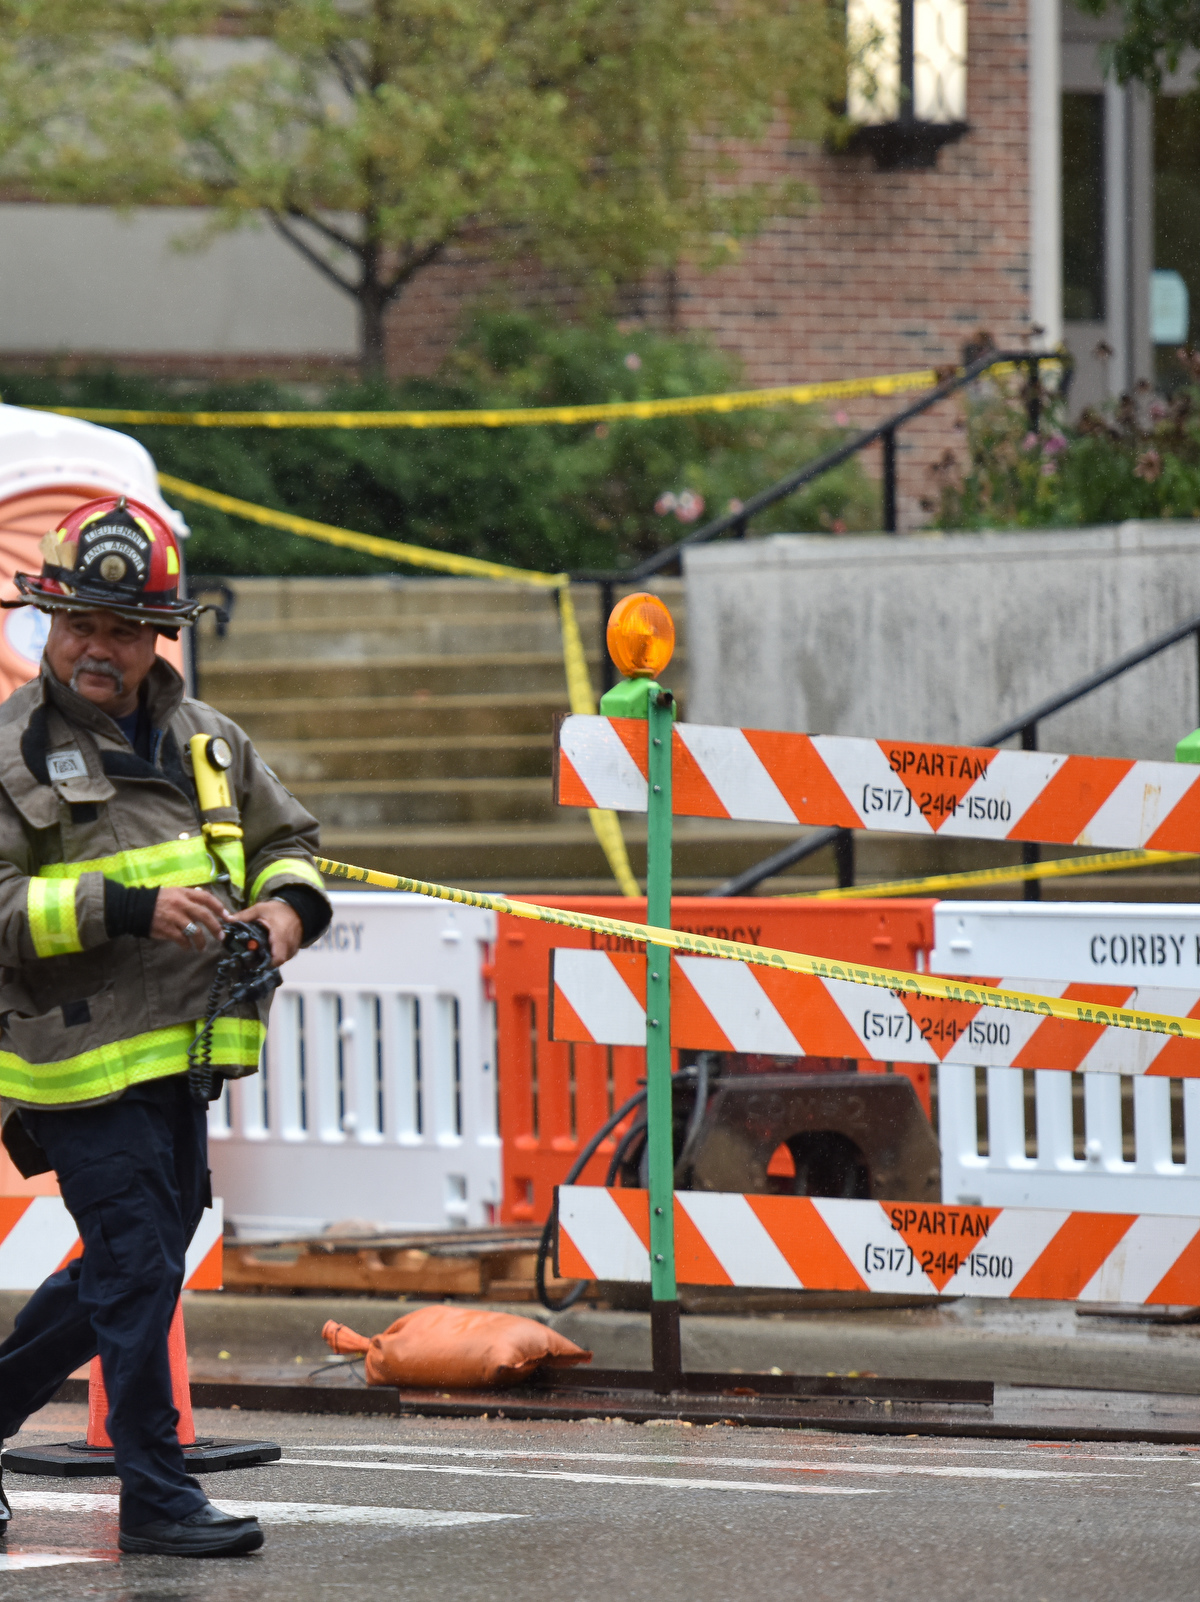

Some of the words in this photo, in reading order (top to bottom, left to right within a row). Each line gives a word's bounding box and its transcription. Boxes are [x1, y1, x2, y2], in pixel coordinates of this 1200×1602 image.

[88, 525, 143, 545] LIEUTENANT
[87, 543, 106, 560] ANN
[111, 541, 142, 567] ARBOR
[889, 750, 988, 780] SPARTAN
[862, 783, 913, 817] (517)
[920, 792, 1012, 823] 244-1500
[1090, 934, 1185, 965] CORBY
[863, 1010, 913, 1044] (517)
[920, 1016, 1011, 1047] 244-1500
[890, 1209, 989, 1239] SPARTAN
[864, 1242, 914, 1277] (517)
[921, 1250, 1014, 1279] 244-1500
